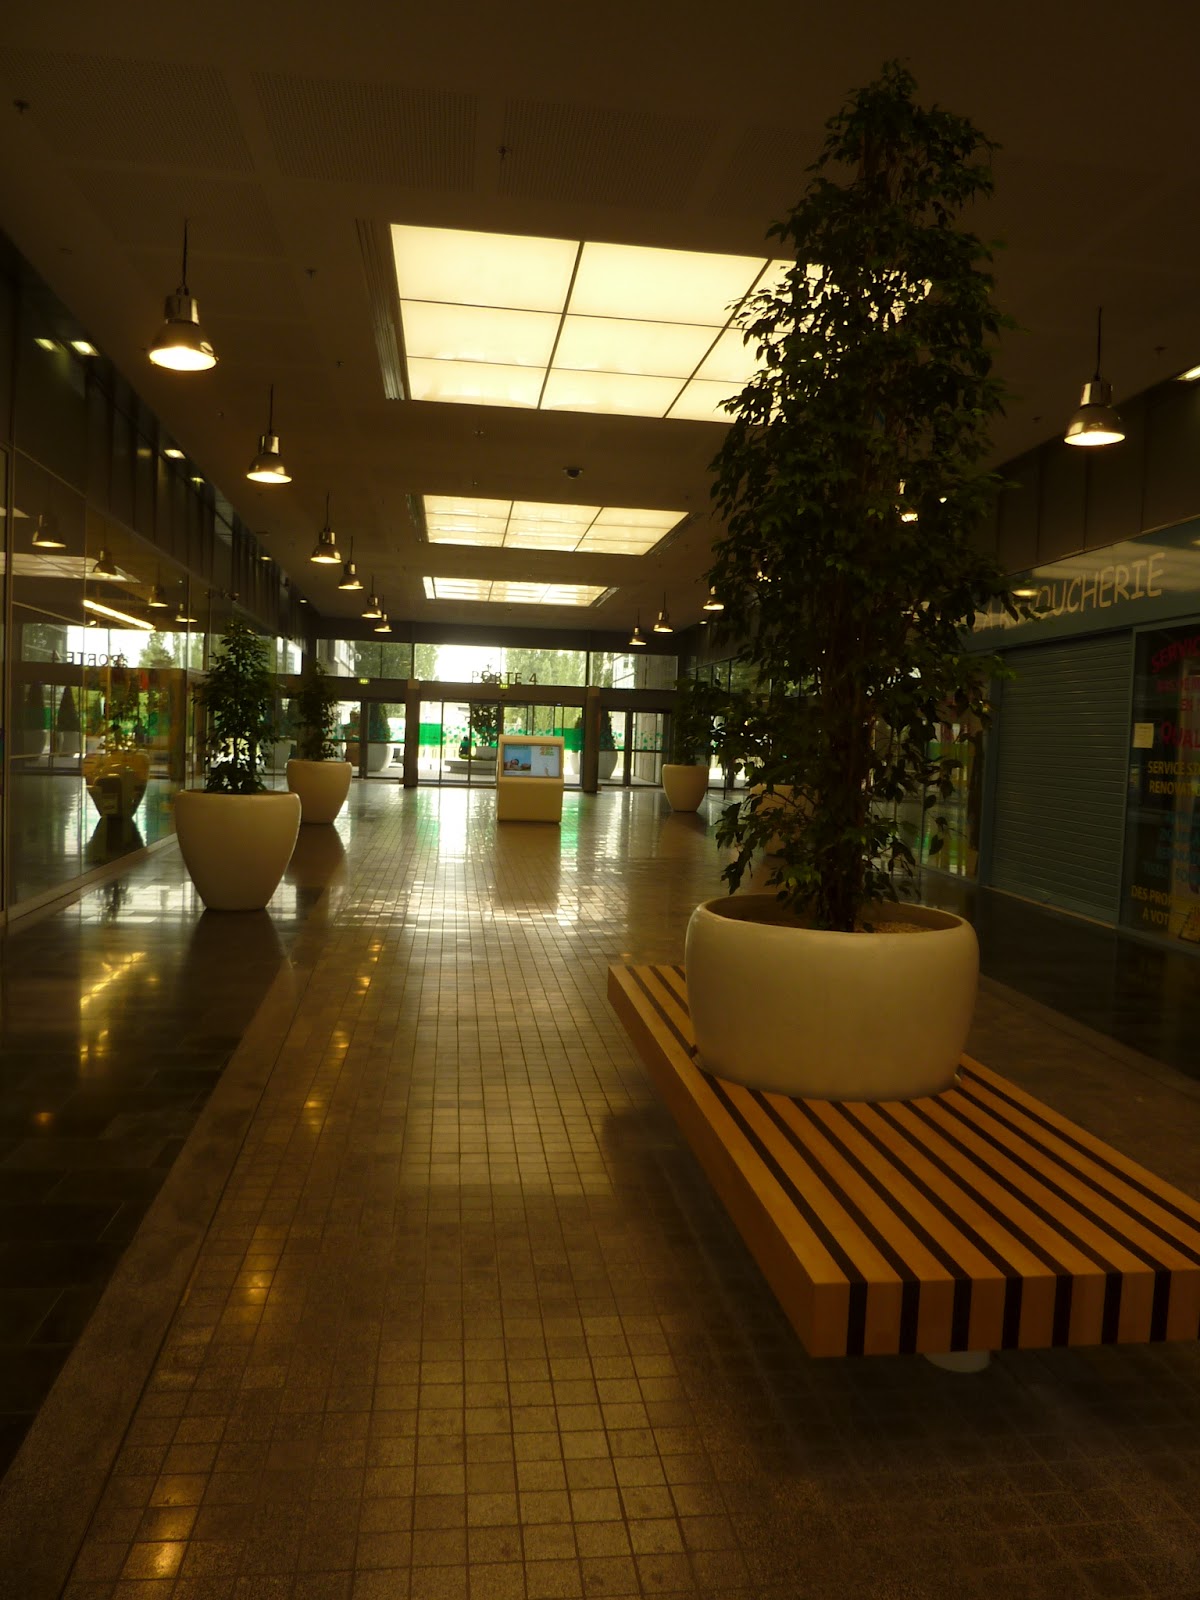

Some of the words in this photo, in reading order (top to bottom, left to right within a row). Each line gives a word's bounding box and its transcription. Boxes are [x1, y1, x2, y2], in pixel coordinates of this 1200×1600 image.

[471, 670, 522, 685] PORTE
[529, 672, 538, 686] 4
[1148, 760, 1184, 775] SERVICE
[1131, 884, 1148, 900] DES
